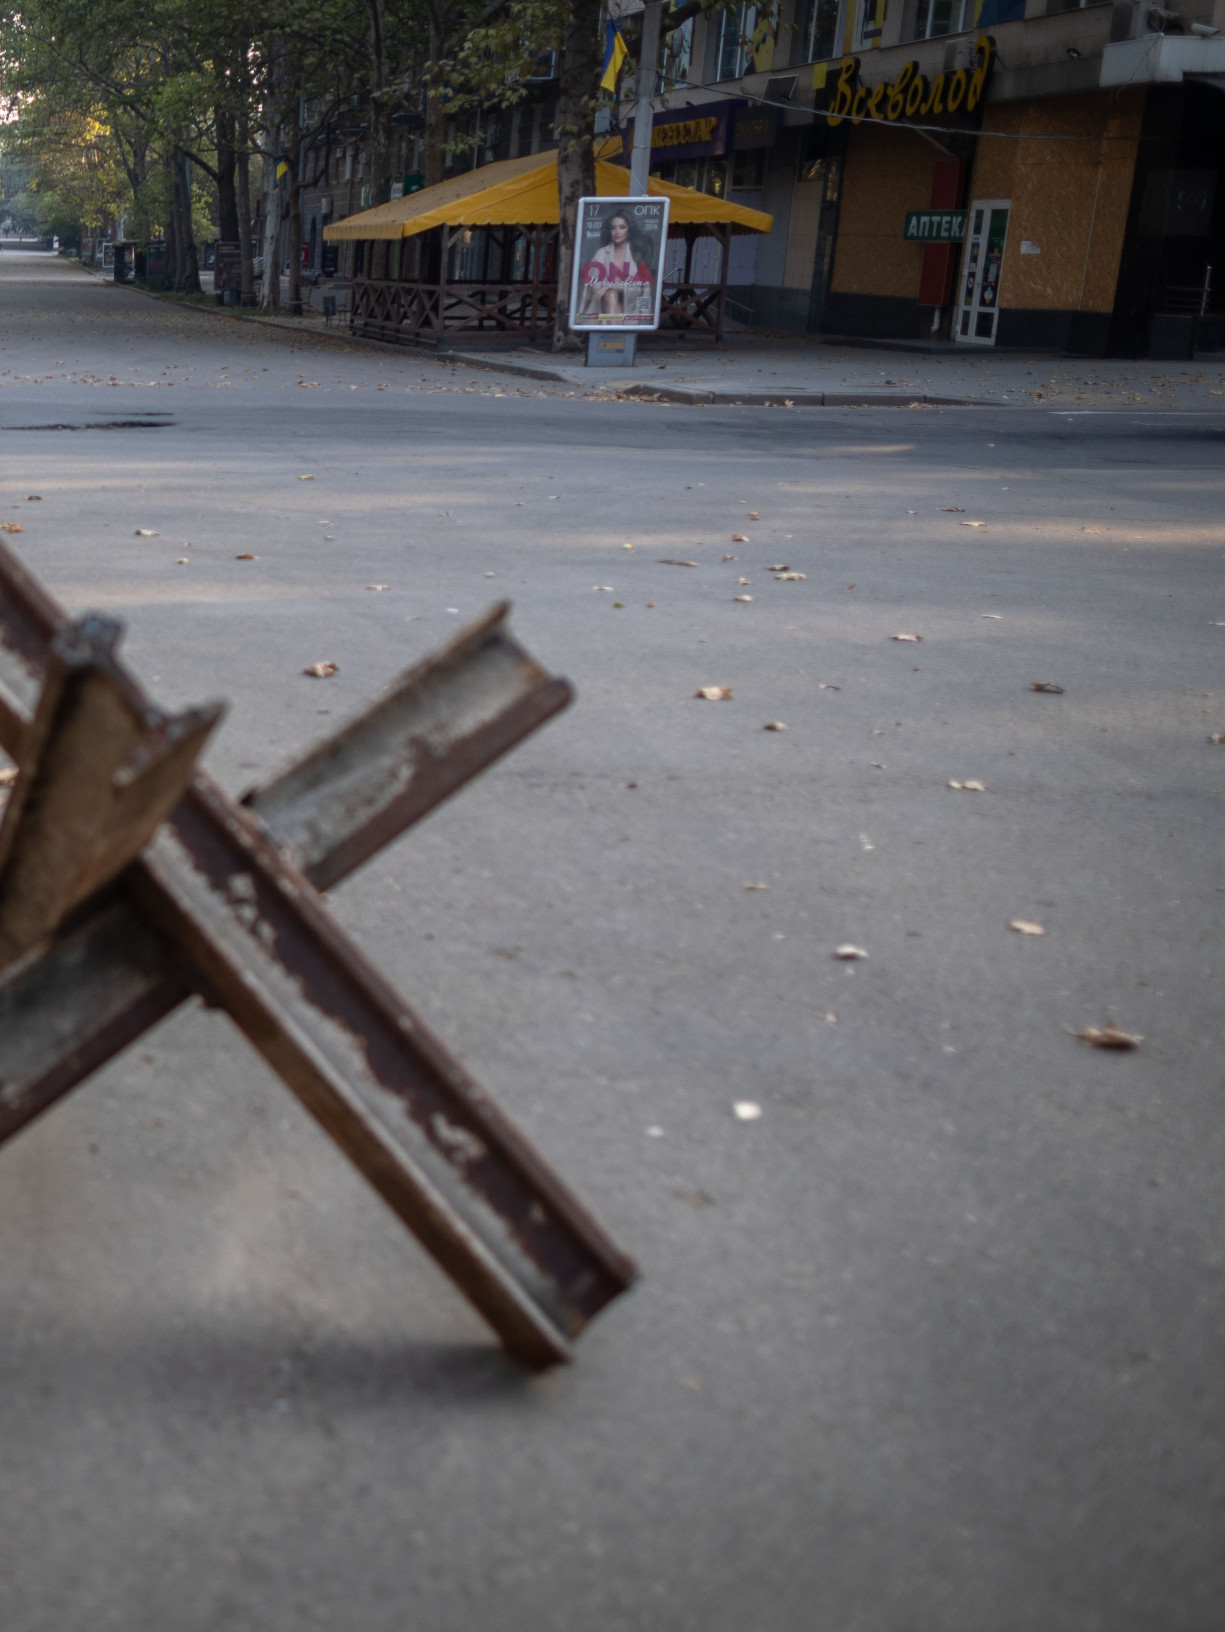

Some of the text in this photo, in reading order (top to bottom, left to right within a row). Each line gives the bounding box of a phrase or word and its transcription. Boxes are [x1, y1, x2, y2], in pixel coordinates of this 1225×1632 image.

[827, 35, 990, 127] Всеволод
[630, 117, 718, 150] КСЕССУАР
[589, 205, 662, 217] 17 ОПК
